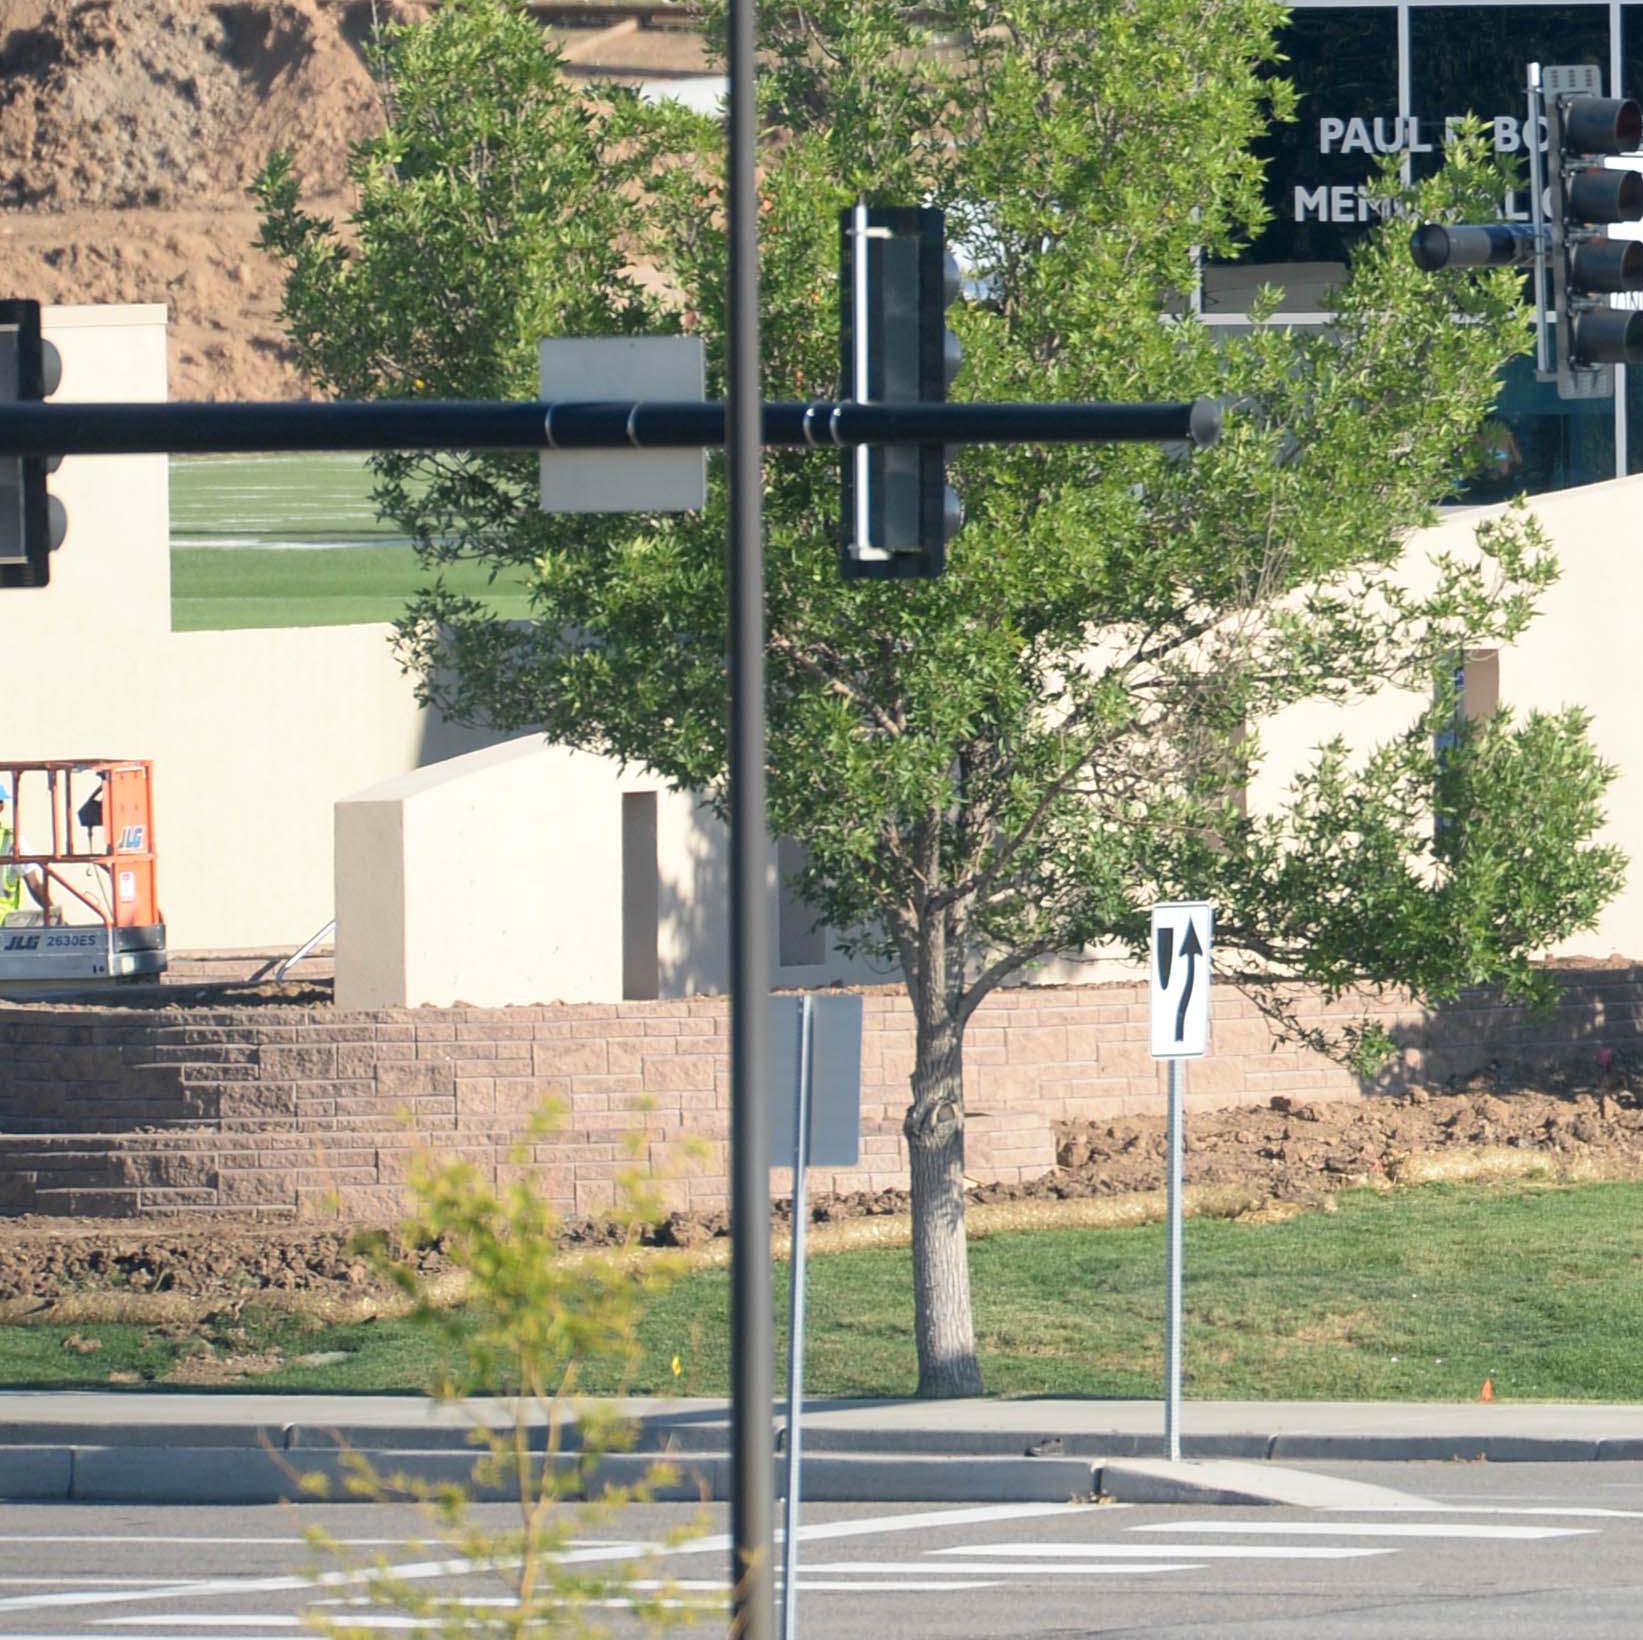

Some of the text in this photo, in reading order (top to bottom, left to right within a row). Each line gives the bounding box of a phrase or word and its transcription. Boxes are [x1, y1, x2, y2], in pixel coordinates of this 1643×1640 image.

[1319, 116, 1433, 154] PAUL
[119, 827, 142, 848] JLG
[4, 935, 40, 951] JLG
